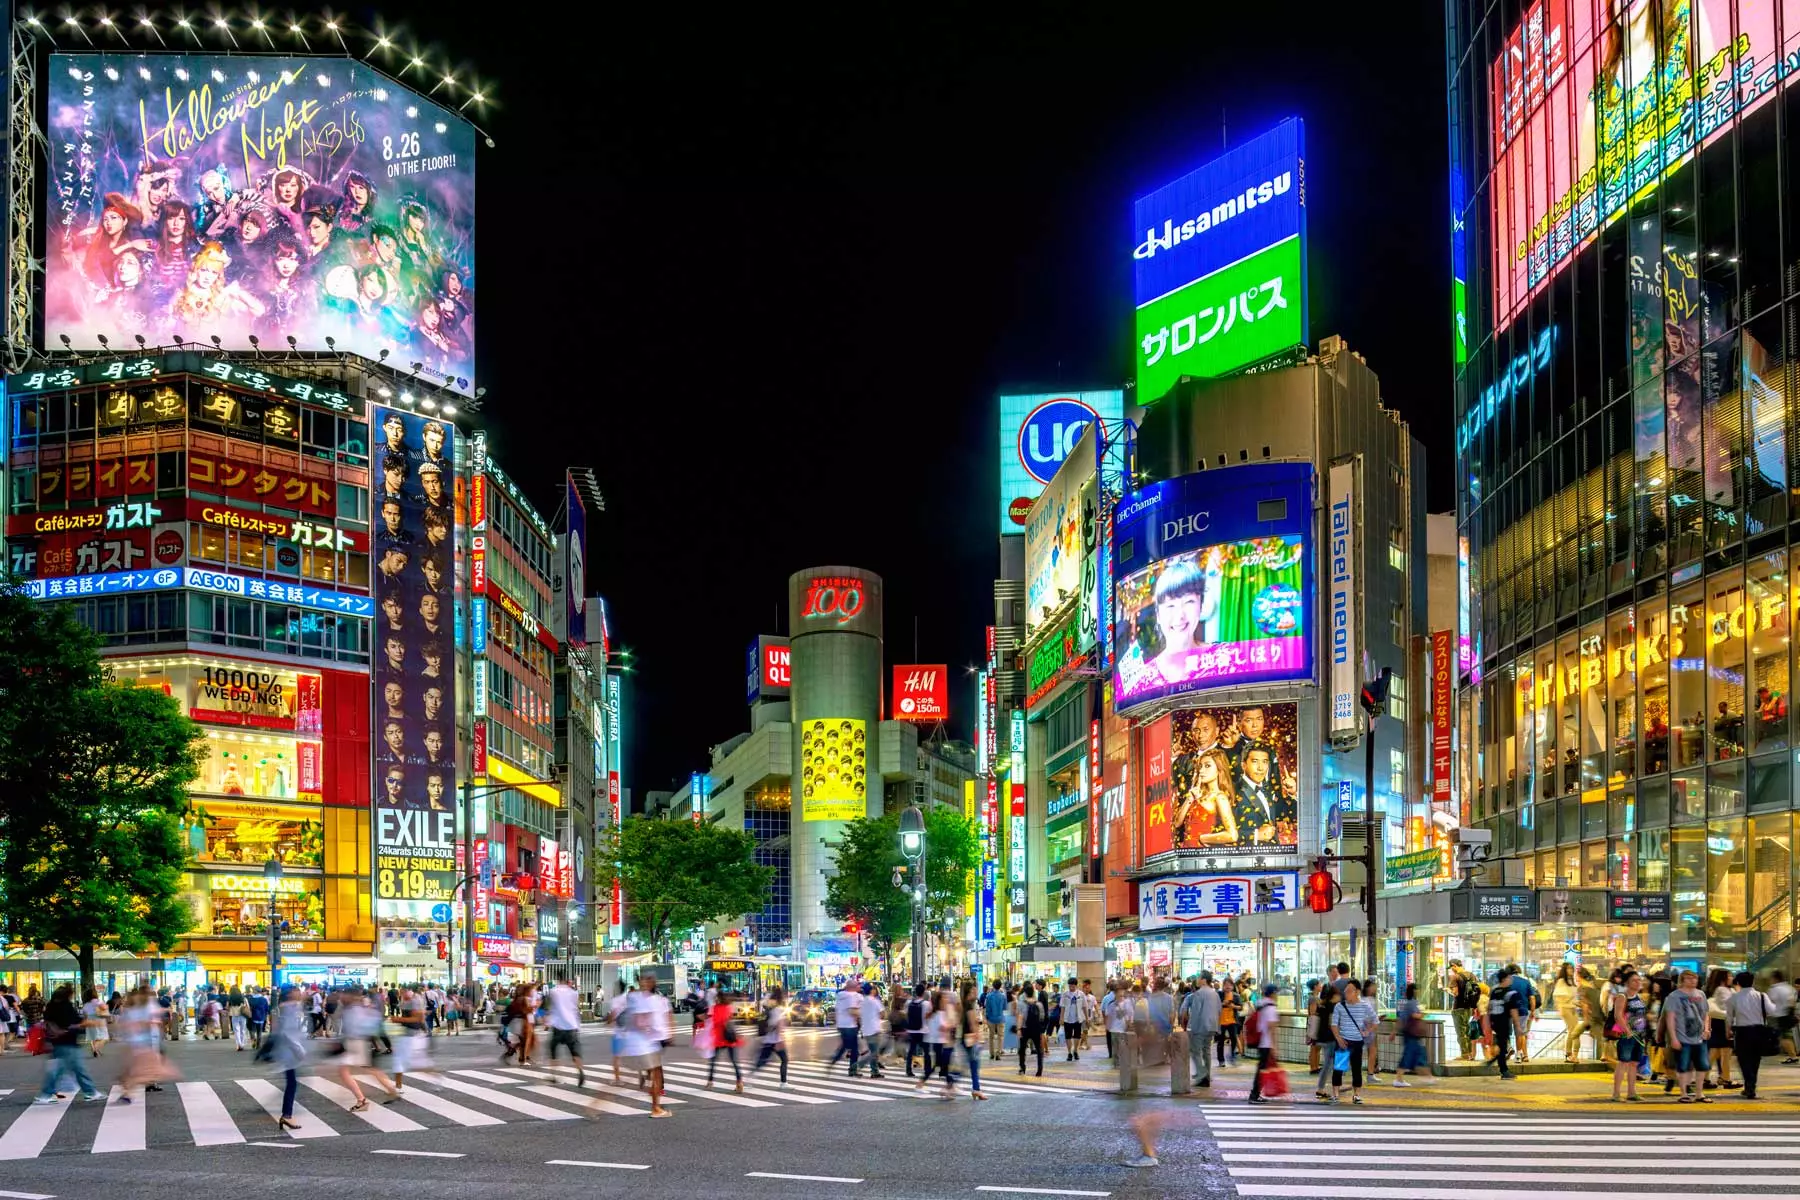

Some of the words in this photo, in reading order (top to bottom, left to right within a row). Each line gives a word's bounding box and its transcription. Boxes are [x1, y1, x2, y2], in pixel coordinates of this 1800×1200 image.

[139, 64, 305, 172] Halloween
[241, 99, 325, 188] Night
[382, 131, 421, 161] 8.26
[387, 164, 399, 178] ON
[401, 161, 420, 175] THE
[421, 155, 456, 173] FLOOR!!
[1133, 171, 1291, 260] Hisamitsu
[1141, 275, 1288, 367] サロンパス
[23, 370, 80, 389] 月の宴
[101, 359, 160, 379] 月の宴
[203, 362, 276, 393] 月の宴
[426, 366, 447, 381] RECORD
[285, 382, 354, 412] 月の宴
[1029, 420, 1095, 463] UC
[40, 460, 152, 494] プライス
[190, 457, 331, 507] コンタクト
[106, 503, 162, 529] ガスト
[1117, 506, 1130, 524] DHC
[1130, 492, 1161, 514] Channel
[202, 508, 287, 535] Caféレストラン
[290, 522, 354, 550] ガスト
[1163, 511, 1210, 542] DHC
[1333, 493, 1350, 584] Taisei
[11, 552, 37, 572] 7F
[43, 548, 73, 564] Café
[76, 540, 144, 575] ガスト
[49, 574, 150, 596] 英会話イーオン
[158, 572, 173, 582] 6F
[189, 571, 240, 592] AEON
[812, 577, 862, 589] SHIBUYA
[250, 580, 369, 612] 英会話イーオン
[801, 587, 864, 624] 109
[1334, 591, 1347, 664] neon
[769, 651, 790, 665] UN
[204, 666, 283, 694] 1000%
[769, 667, 790, 682] QL
[904, 671, 936, 693] H&M
[1178, 682, 1195, 691] DHC
[1434, 635, 1449, 728] クスリのことなら
[204, 686, 283, 706] WEDDING!
[609, 680, 618, 697] BIC
[1335, 693, 1351, 702] (03)
[609, 701, 619, 742] CAMERA
[917, 704, 940, 713] 150m
[1334, 710, 1352, 719] 2468
[1150, 749, 1165, 778] No.1
[1434, 735, 1450, 794] 三千里
[1149, 802, 1166, 827] FX
[378, 808, 454, 849] EXILE
[378, 846, 412, 856] 24karats
[412, 847, 434, 857] GOLD
[435, 849, 454, 858] SOUL
[379, 857, 409, 869] NEW
[411, 858, 454, 871] SINGLE
[379, 869, 425, 898] 8.19
[426, 879, 439, 890] ON
[1480, 904, 1510, 916] 渋谷駅
[541, 914, 558, 935] USH
